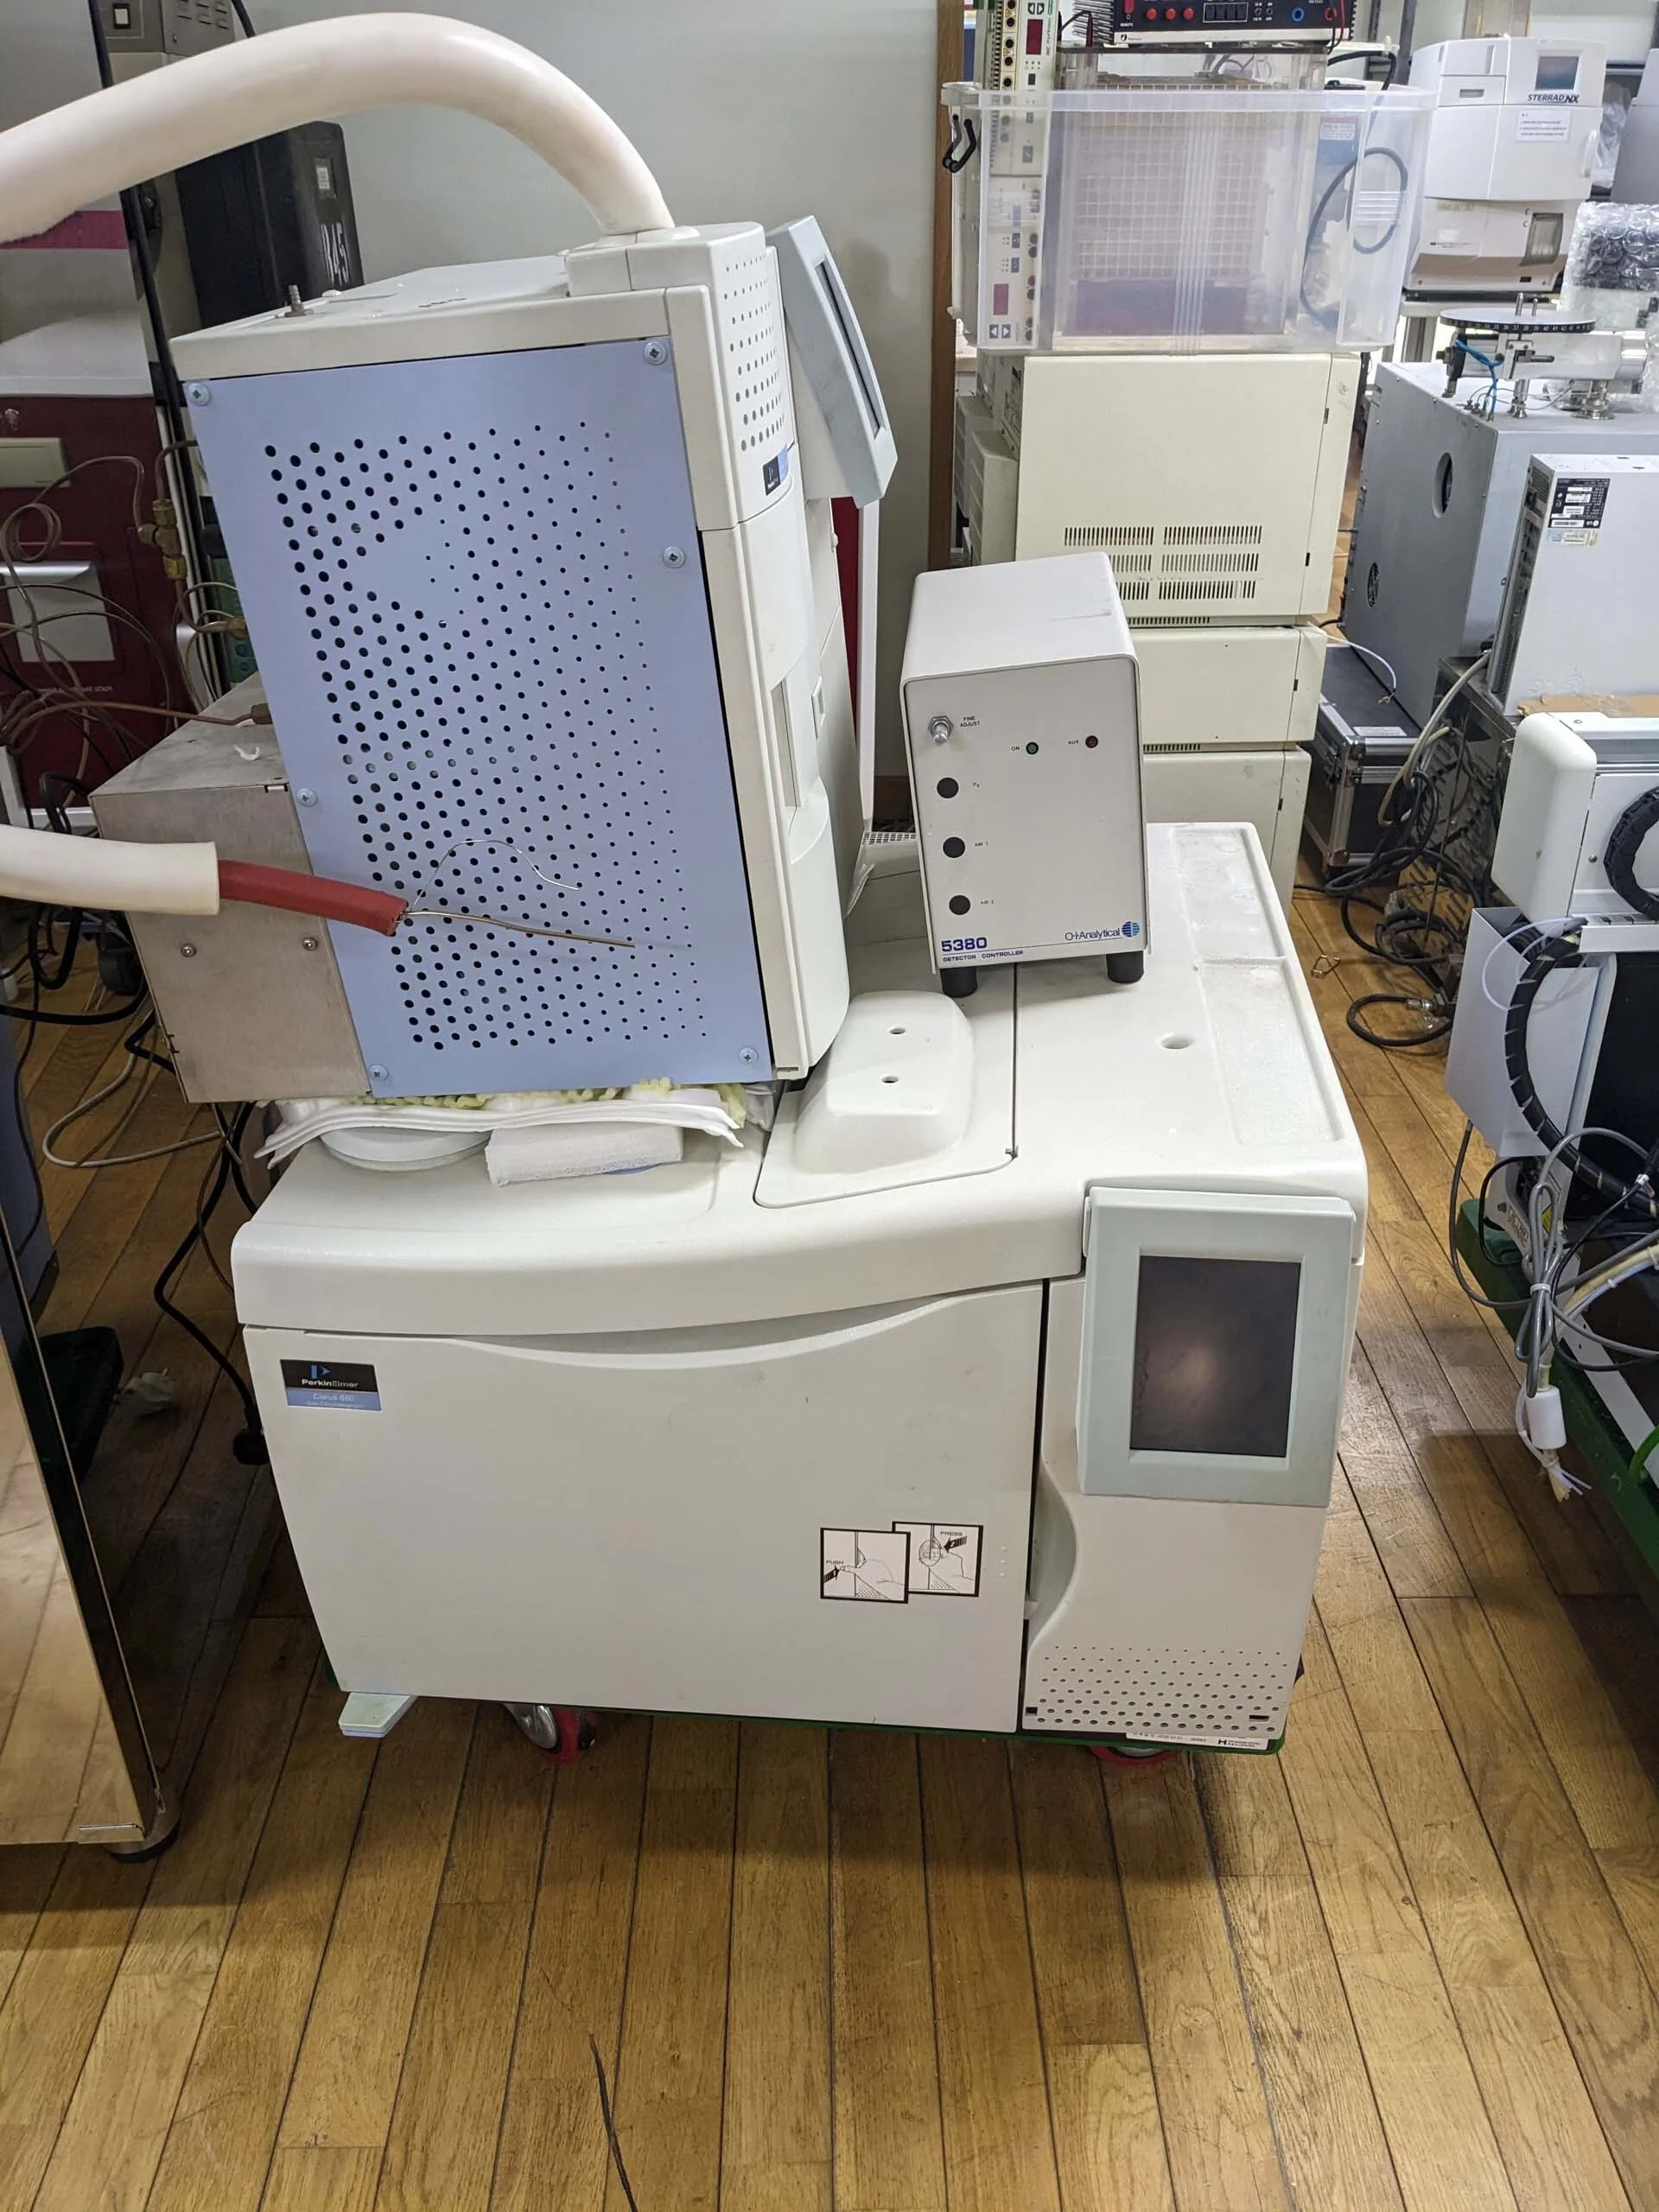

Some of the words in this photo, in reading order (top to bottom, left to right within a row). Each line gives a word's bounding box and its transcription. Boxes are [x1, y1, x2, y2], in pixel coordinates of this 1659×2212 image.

[1528, 93, 1565, 102] STERRAD
[1565, 94, 1580, 104] NX
[941, 937, 988, 952] 5380
[943, 954, 976, 963] DETECTOR
[982, 950, 1024, 959] CONTROLLER
[302, 1378, 359, 1388] PerkinElmer
